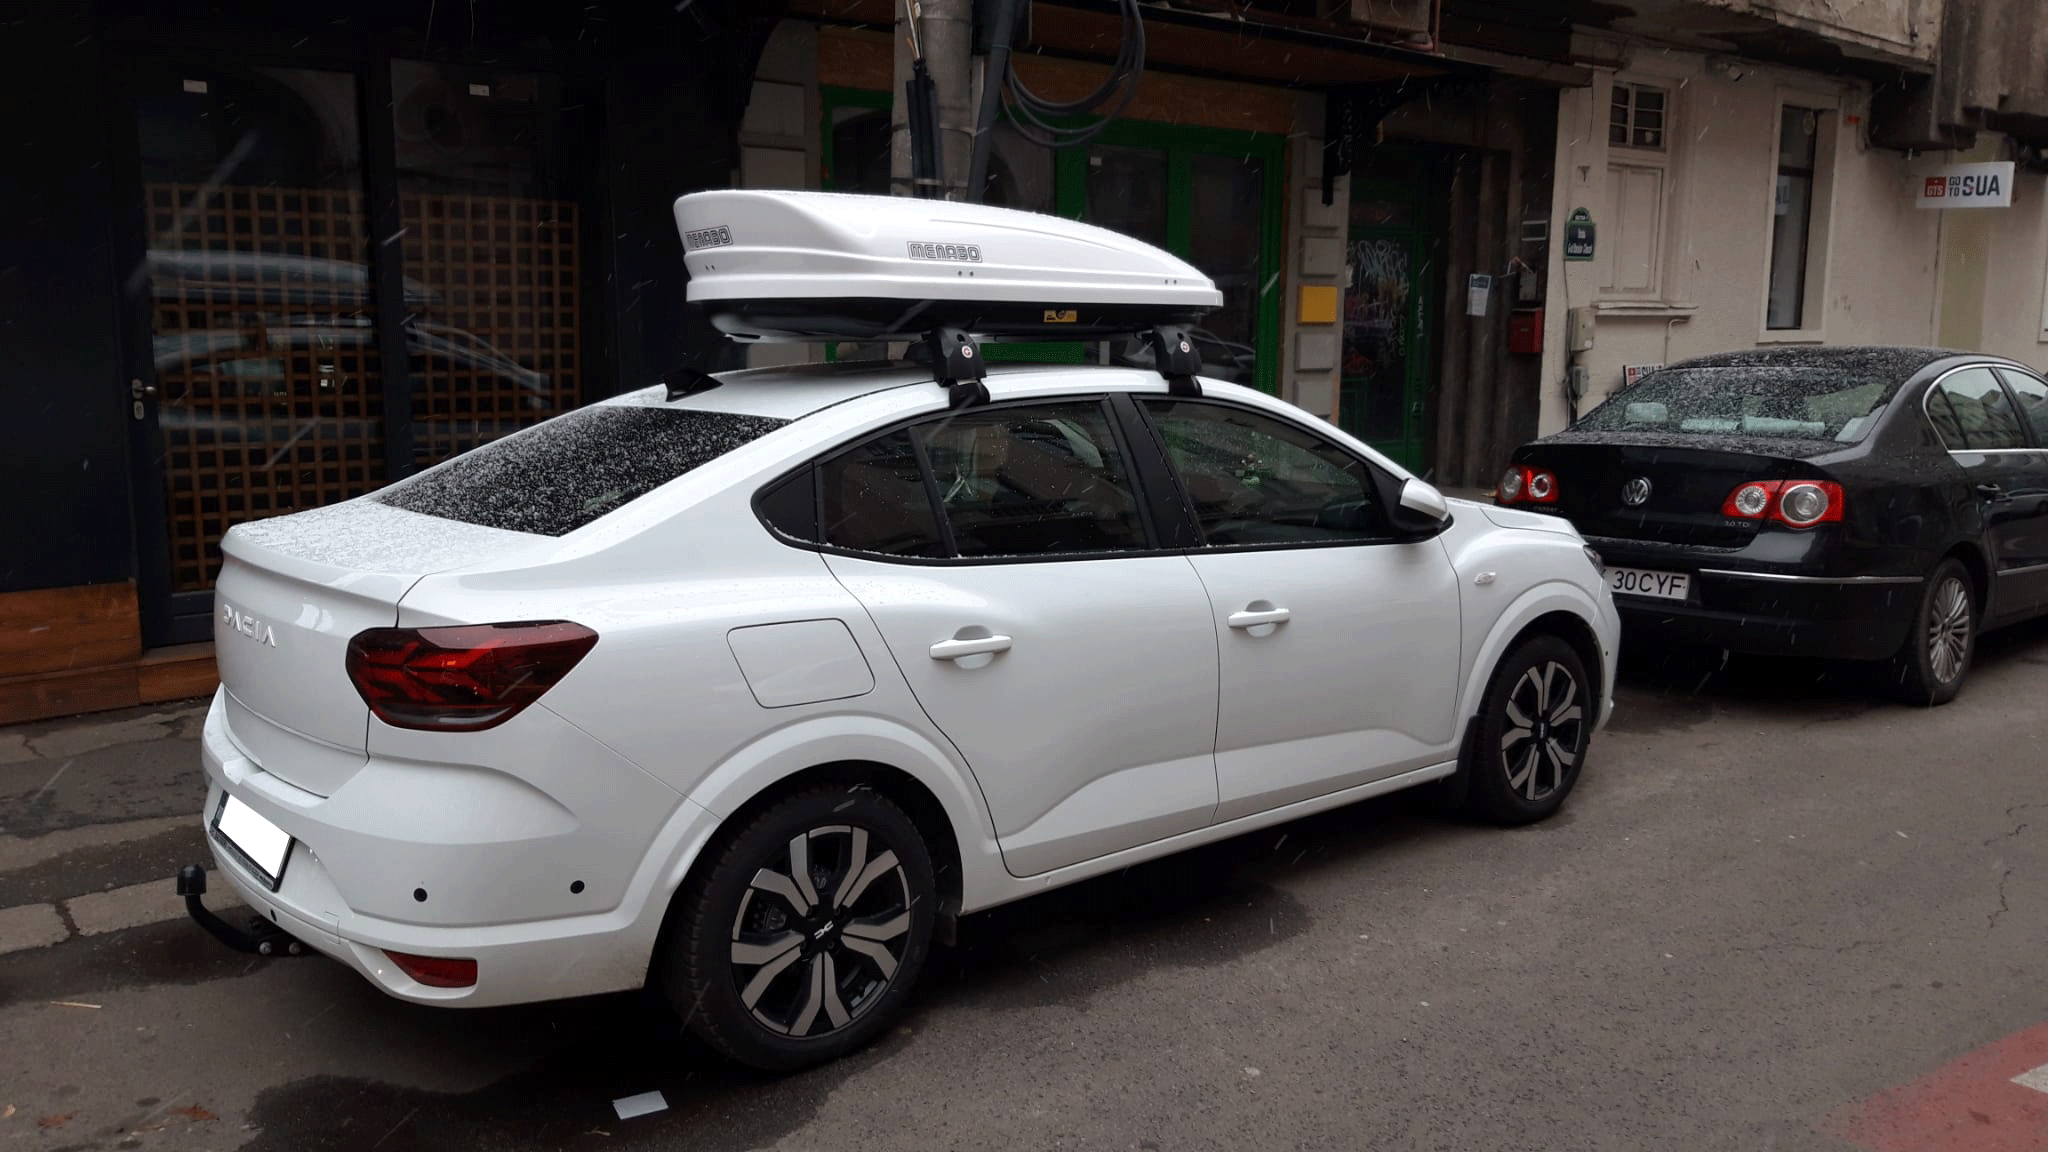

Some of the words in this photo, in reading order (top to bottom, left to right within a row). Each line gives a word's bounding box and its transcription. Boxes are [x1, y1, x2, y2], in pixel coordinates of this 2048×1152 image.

[1949, 176, 1961, 186] GO
[1962, 175, 2000, 197] SUA
[1949, 187, 1960, 197] TO
[910, 243, 980, 261] MENABO
